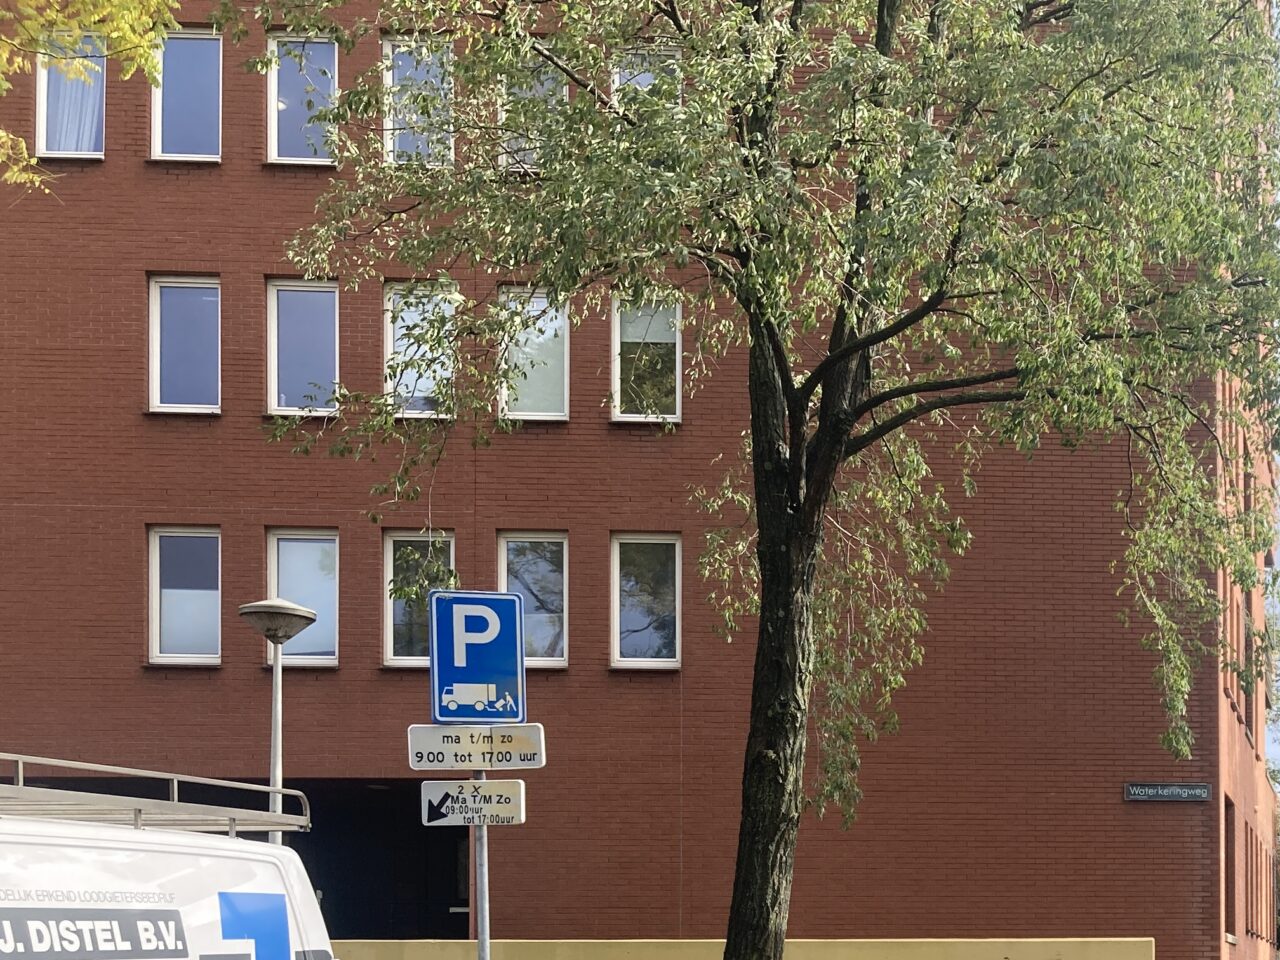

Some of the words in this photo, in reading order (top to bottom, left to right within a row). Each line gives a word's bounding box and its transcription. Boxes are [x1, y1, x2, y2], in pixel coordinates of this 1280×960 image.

[453, 604, 501, 667] P
[442, 734, 461, 744] ma
[470, 733, 493, 744] t/m
[500, 735, 513, 744] zo
[454, 752, 473, 763] tot
[519, 753, 538, 762] uur
[457, 785, 464, 795] 2
[1129, 786, 1208, 797] Waterkeringweg
[450, 795, 467, 805] Ma
[471, 795, 492, 805] T/M
[496, 795, 511, 805] Zo
[463, 815, 475, 824] tot
[477, 815, 515, 824] 17:00uur
[36, 890, 76, 902] ERKEND
[77, 890, 175, 904] LOODGIETERSBEDRIJF
[27, 920, 131, 952] DISTEL
[137, 920, 183, 951] B.V.
